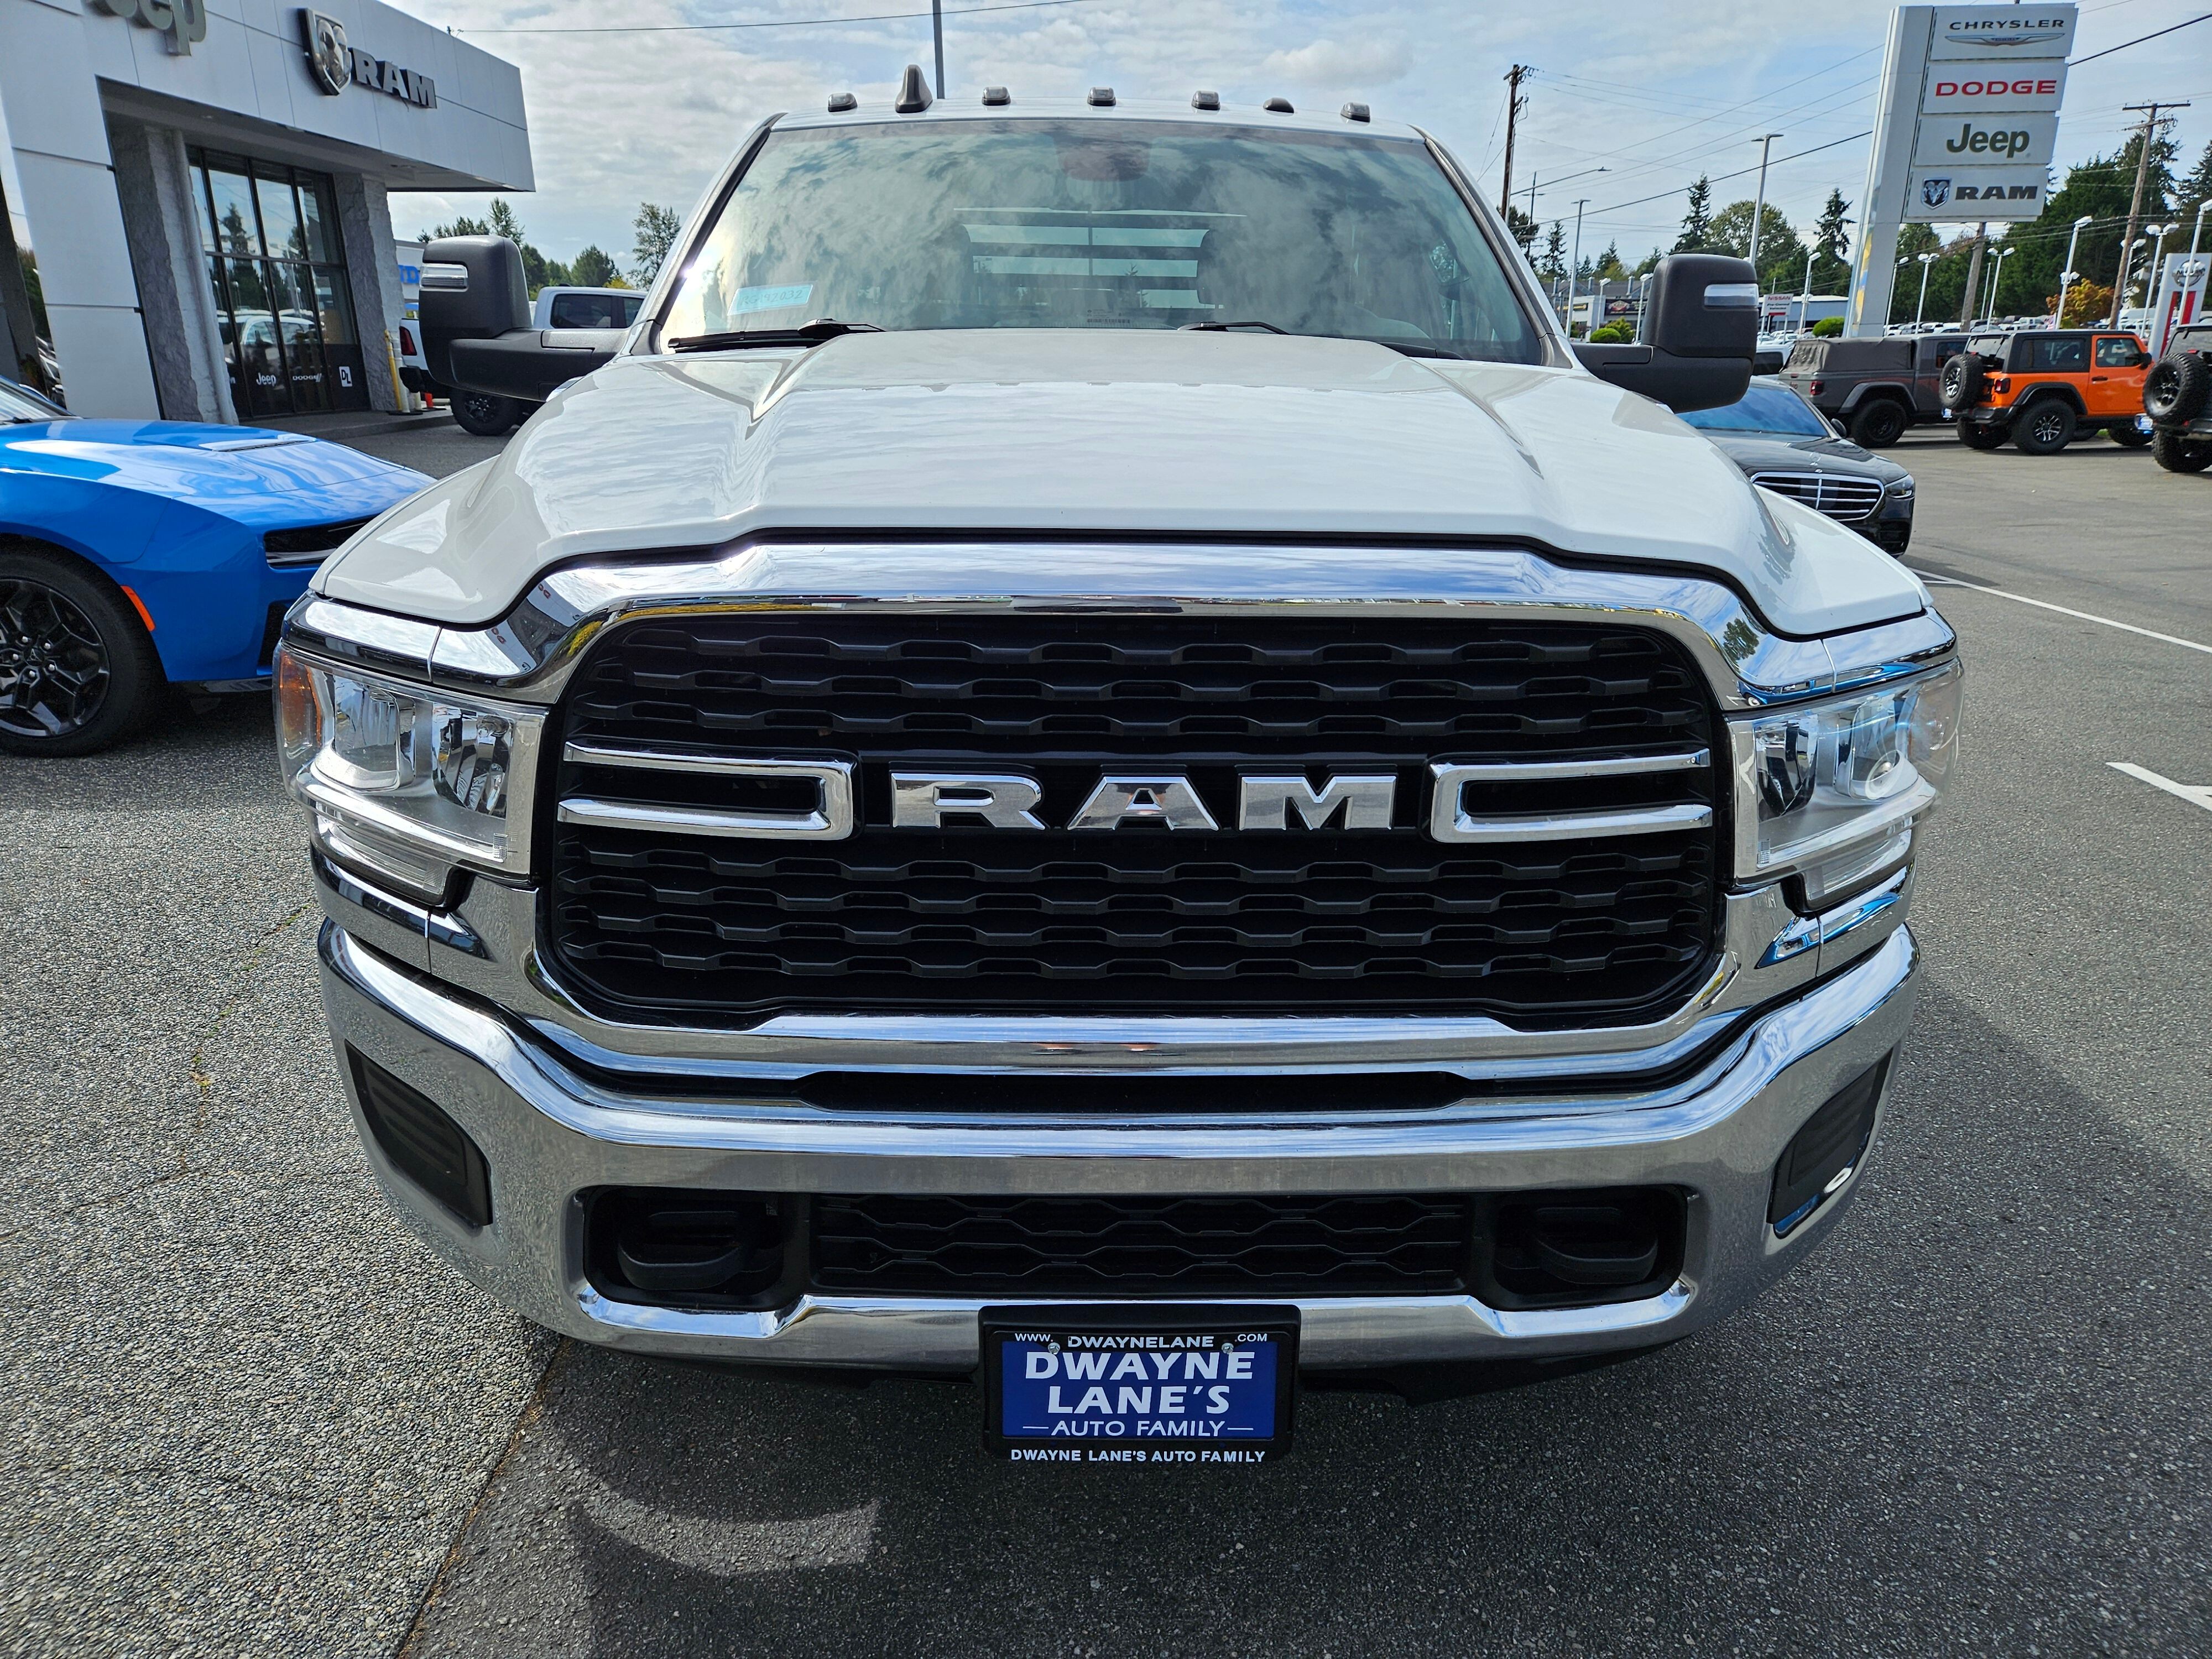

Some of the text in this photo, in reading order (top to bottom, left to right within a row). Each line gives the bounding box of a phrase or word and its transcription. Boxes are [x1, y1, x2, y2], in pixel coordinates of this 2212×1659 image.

[1949, 19, 2064, 30] CHRYSLER
[348, 48, 437, 109] RAM
[1936, 80, 2057, 96] DODGE
[1947, 123, 2030, 158] Jeep
[1955, 186, 2038, 200] RAM
[256, 372, 277, 387] Jeep
[890, 772, 1397, 832] RAM
[1014, 1333, 1268, 1348] WWW. DWAYNELANE .COM
[1025, 1351, 1255, 1380] DWAYNE
[1047, 1385, 1230, 1414] LANE'S
[1051, 1420, 1225, 1437] AUTO FAMILY
[1011, 1449, 1265, 1463] DWAYNE LANE'S AUTO FAMILY
